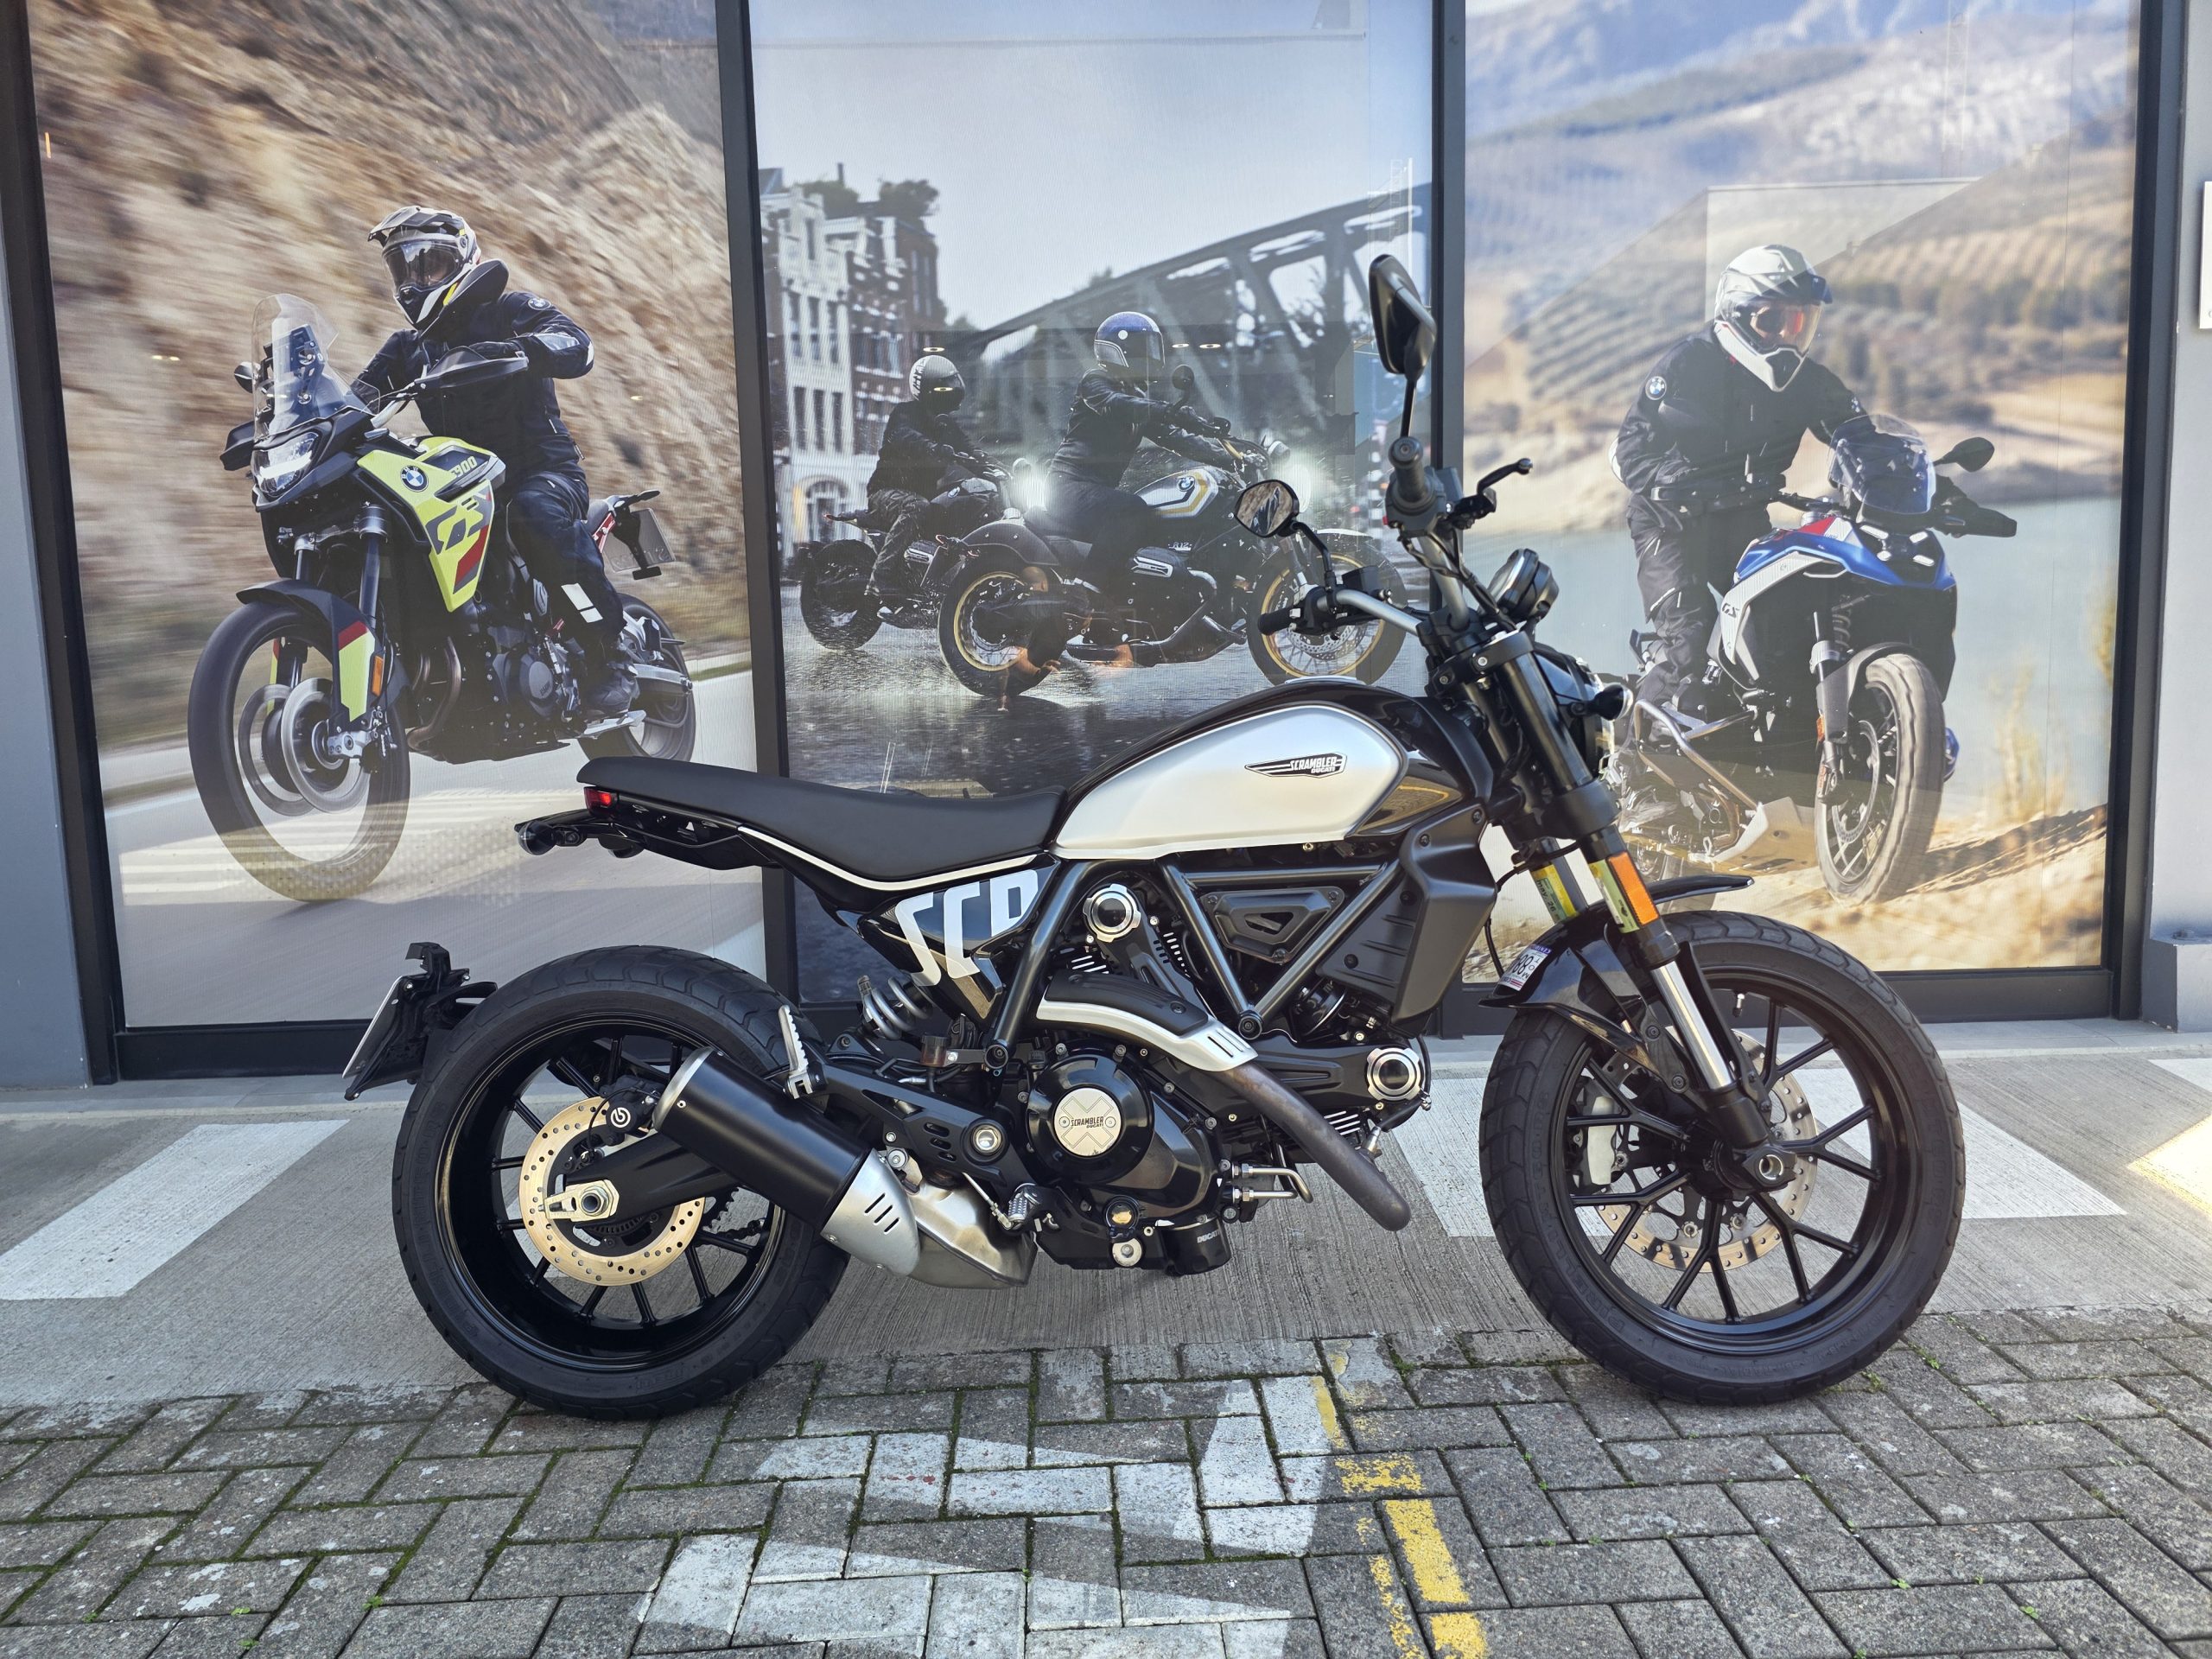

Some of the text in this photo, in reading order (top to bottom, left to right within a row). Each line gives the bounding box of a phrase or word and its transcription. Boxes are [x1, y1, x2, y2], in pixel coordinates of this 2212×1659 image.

[1722, 602, 1740, 619] GS
[1289, 756, 1338, 772] SCRAMBLER
[1071, 1116, 1104, 1127] SCRAMBLER
